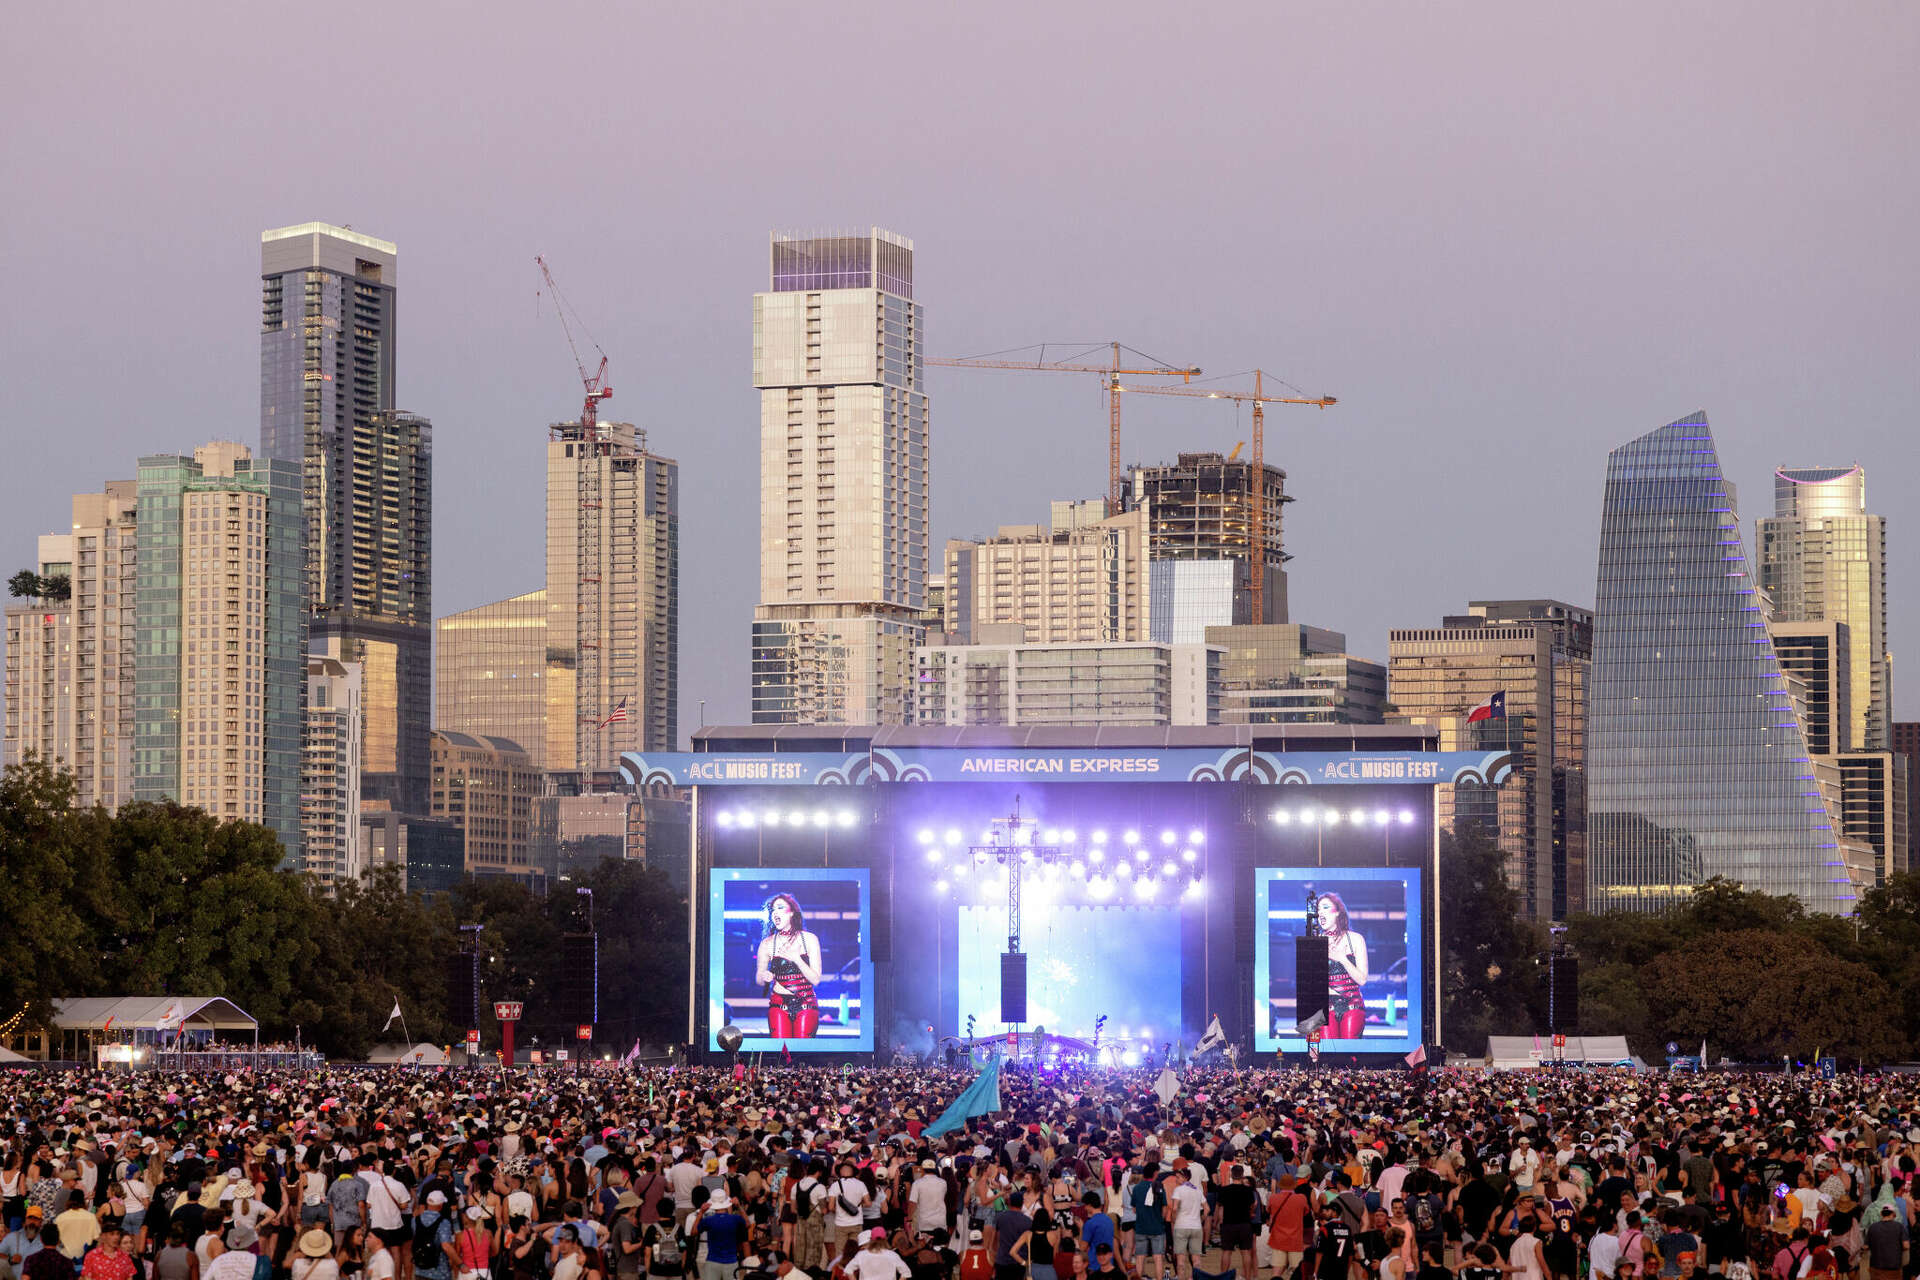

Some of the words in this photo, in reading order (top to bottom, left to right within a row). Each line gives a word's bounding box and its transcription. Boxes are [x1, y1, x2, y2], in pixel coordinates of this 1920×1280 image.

[690, 762, 724, 779] ACL
[726, 762, 769, 779] MUSIC
[771, 762, 802, 779] FEST
[960, 758, 1063, 773] AMERICAN
[1069, 758, 1160, 773] EXPRESS
[1325, 762, 1359, 779] ACL
[1361, 762, 1404, 778] MUSIC
[1407, 762, 1438, 778] FEST
[1561, 1218, 1570, 1232] 8
[1337, 1238, 1346, 1257] 7
[972, 1254, 979, 1269] 1
